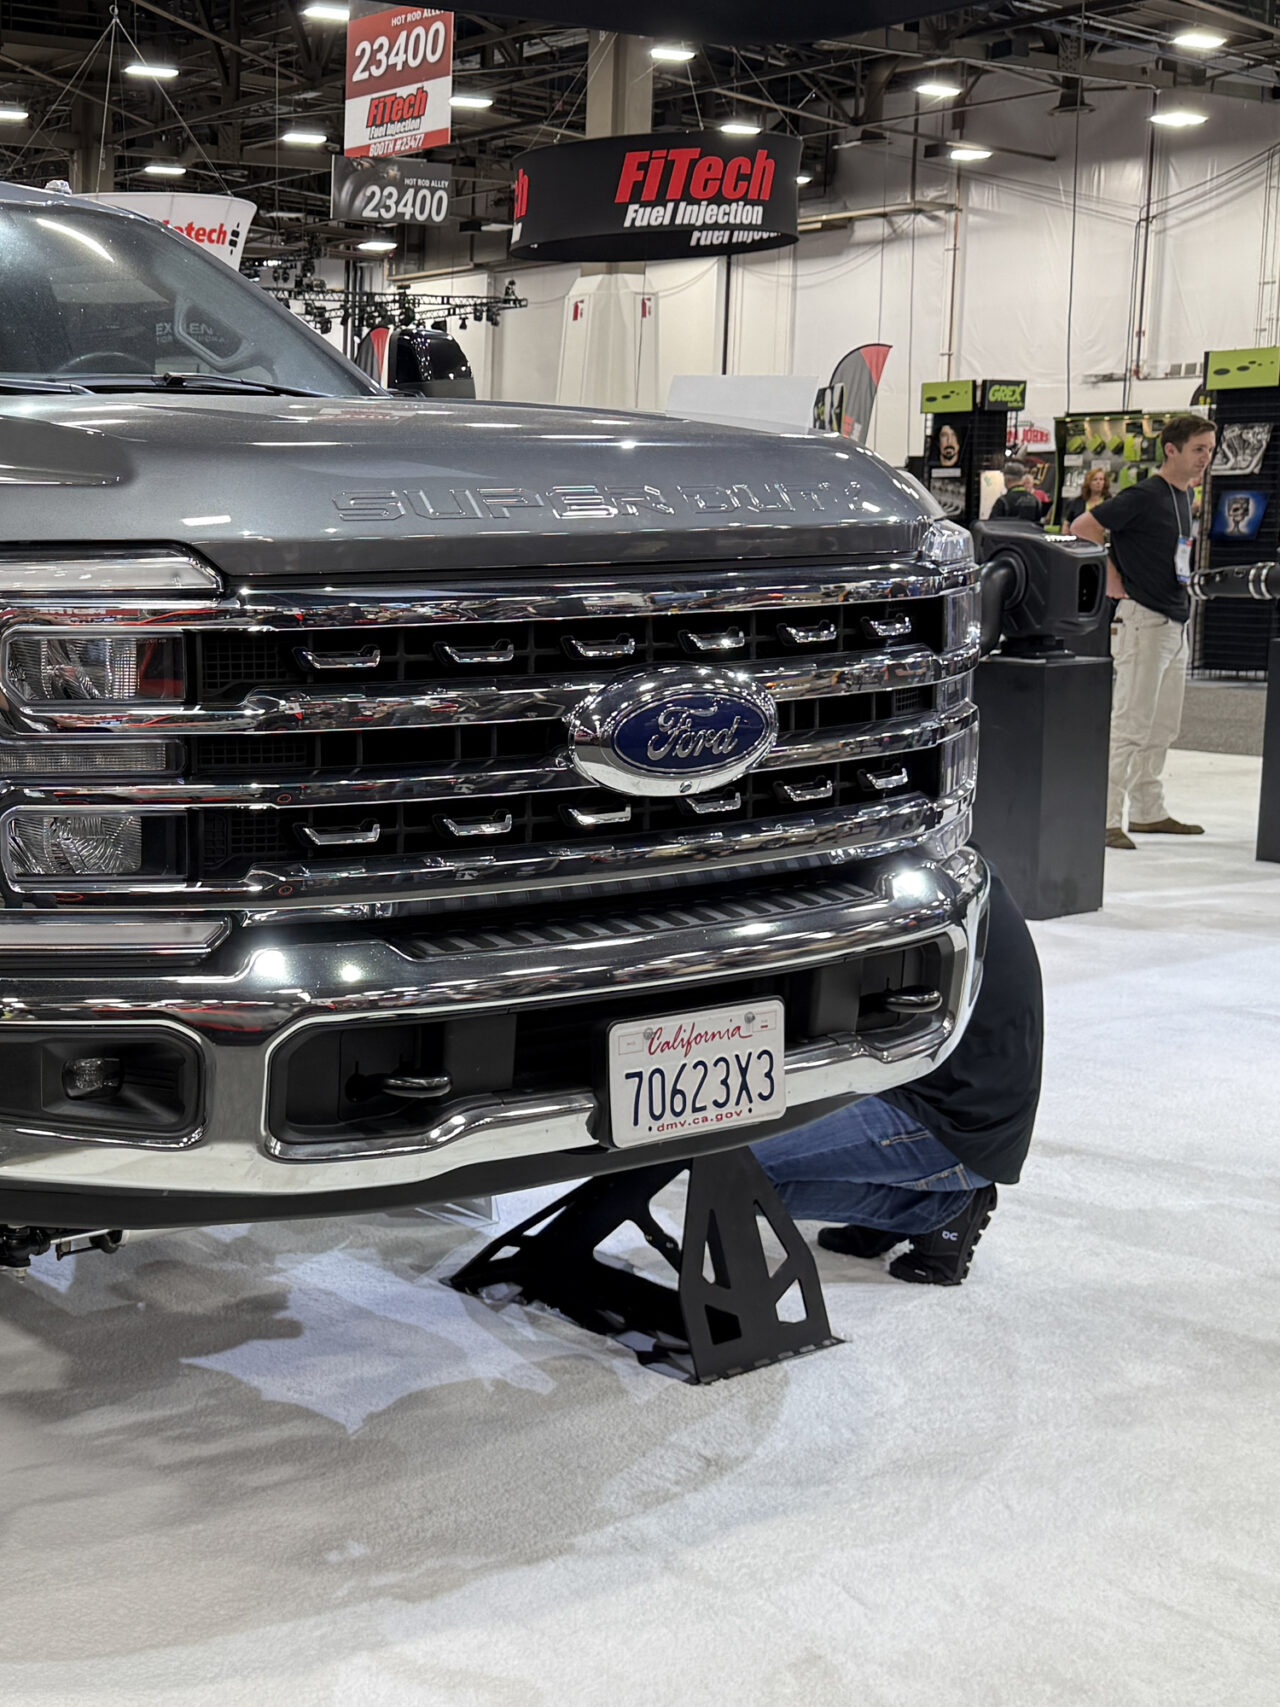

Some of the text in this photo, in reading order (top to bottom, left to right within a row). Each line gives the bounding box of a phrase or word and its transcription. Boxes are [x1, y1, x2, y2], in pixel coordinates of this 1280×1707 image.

[391, 8, 444, 27] HOT ROD ALL
[352, 20, 446, 83] 23400
[366, 86, 428, 129] FiTech
[369, 140, 394, 157] BOOTH
[404, 178, 449, 188] HOT ROD ALLEY
[614, 148, 776, 203] FiTech
[362, 185, 449, 223] 23400
[623, 200, 764, 228] Fuel Injection
[163, 219, 228, 246] tech
[988, 384, 1024, 402] GREX
[333, 484, 676, 523] SUPER
[647, 699, 741, 761] Ford
[648, 1022, 753, 1058] California
[625, 1049, 775, 1127] 70623X3
[656, 1109, 743, 1132] dmv.ca.gov
